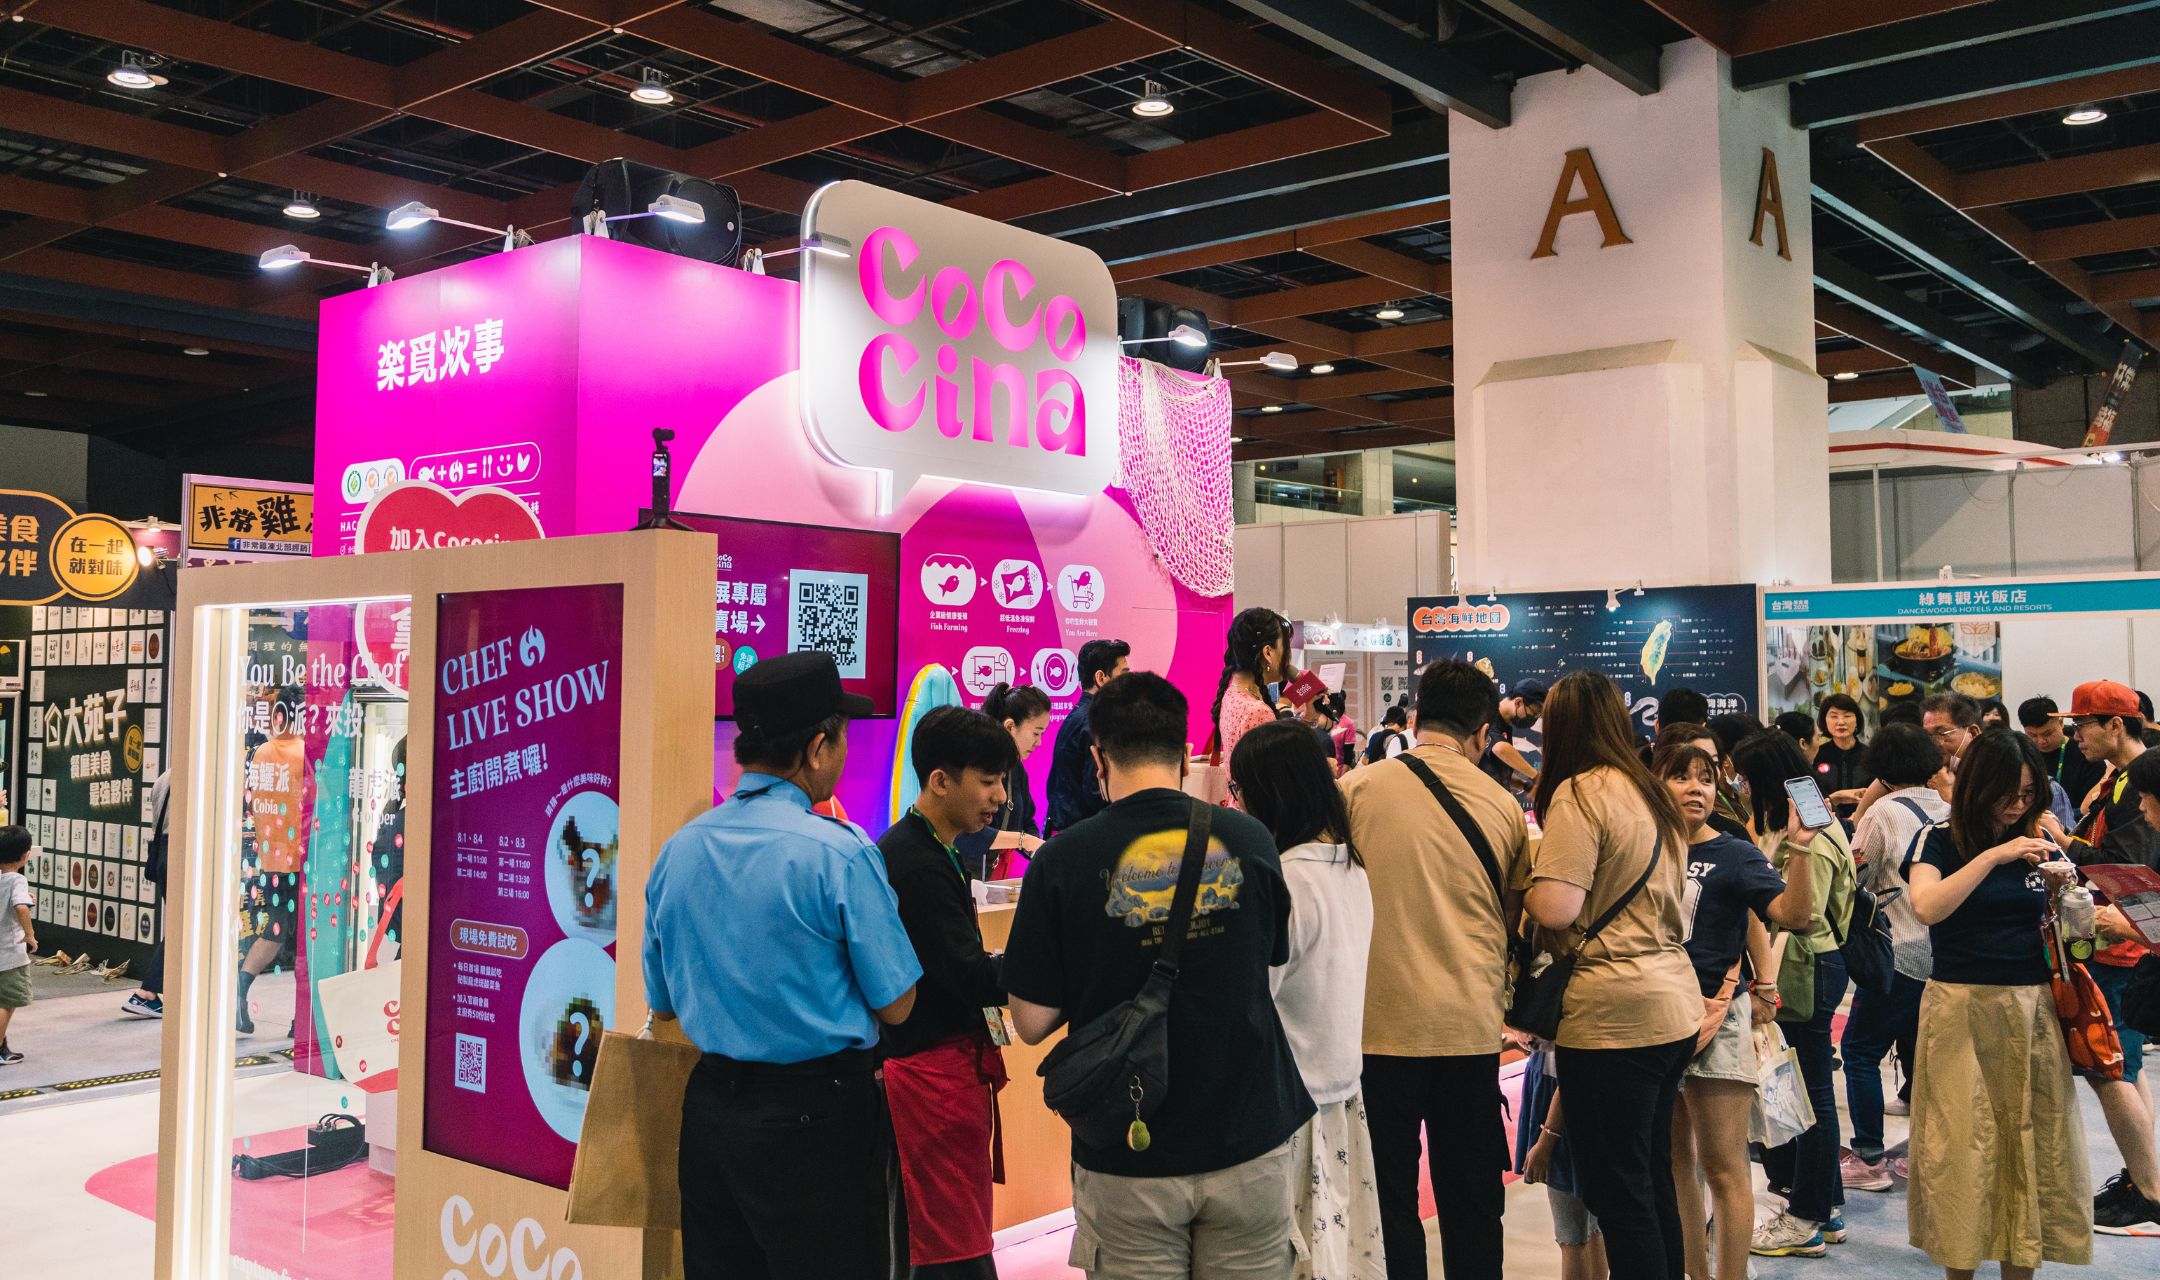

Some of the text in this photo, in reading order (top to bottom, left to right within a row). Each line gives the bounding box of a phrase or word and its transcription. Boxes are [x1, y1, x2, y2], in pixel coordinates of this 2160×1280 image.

[1531, 146, 1634, 259] A
[1749, 147, 1792, 261] A
[859, 226, 1086, 362] CoCo
[859, 333, 1086, 457] Cina
[0, 514, 40, 544] 食
[198, 495, 314, 538] 非常雞
[70, 537, 124, 554] 在一起
[69, 558, 123, 576] 就對味
[1897, 606, 1958, 615] DANCEWOODS
[1959, 605, 1991, 613] HOTELS
[2014, 603, 2053, 611] RESORTS
[1918, 589, 2027, 606] 綠舞觀光飯店
[930, 622, 968, 633] Fish Farming
[1006, 625, 1030, 635] Freezing
[1420, 610, 1501, 626] 台灣海鮮地圖
[239, 650, 410, 688] You Be the Chef
[442, 636, 512, 695] CHEF
[63, 688, 127, 747] 大苑子
[446, 660, 609, 751] LIVE SHOW
[450, 743, 549, 800] 主廚開煮囉!
[89, 778, 133, 808] 最強夥伴
[253, 799, 278, 816] Cobia
[459, 927, 517, 951] 現場免費試吃
